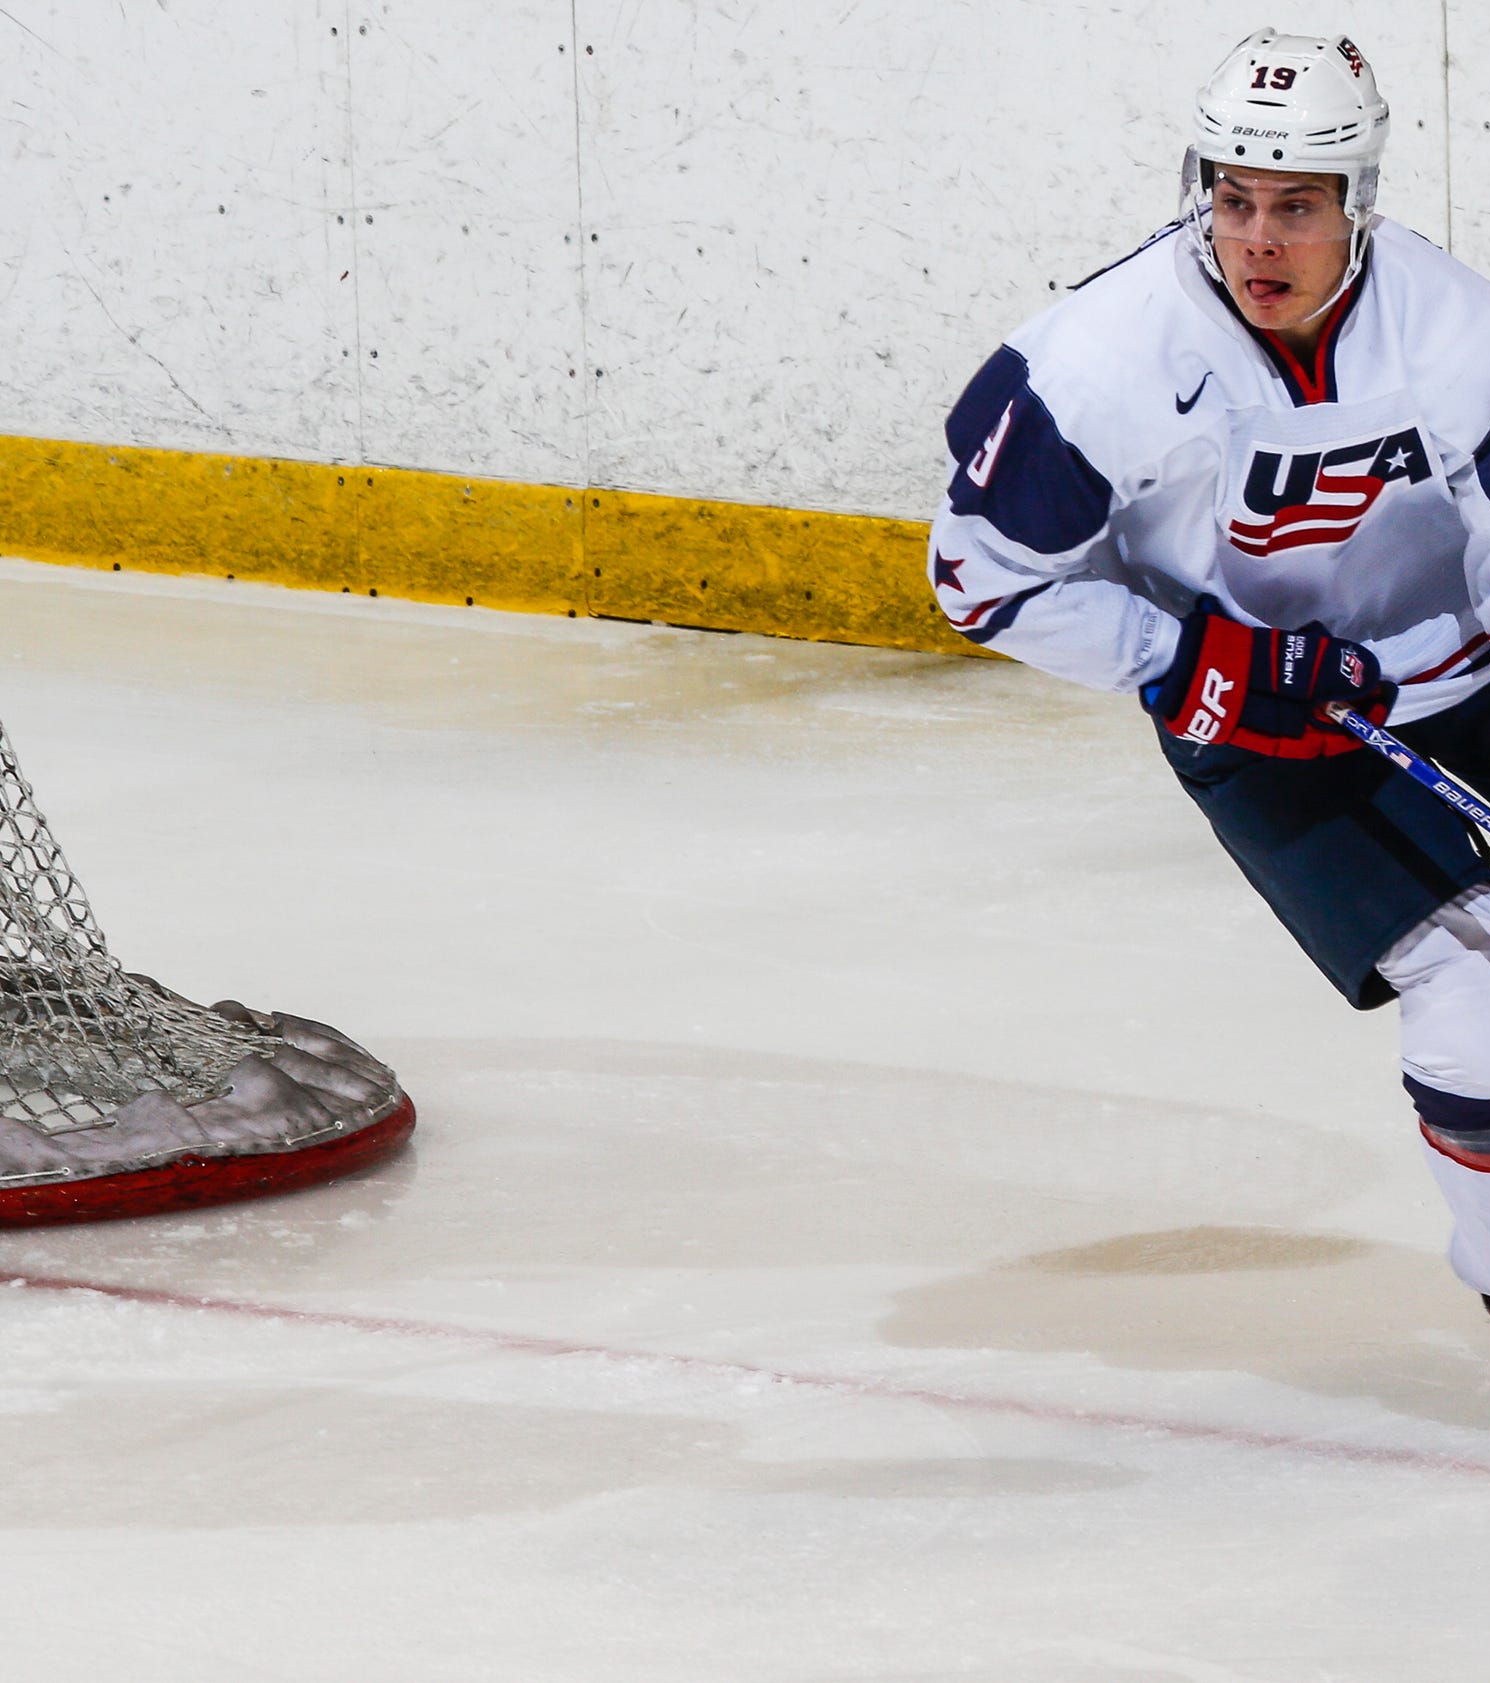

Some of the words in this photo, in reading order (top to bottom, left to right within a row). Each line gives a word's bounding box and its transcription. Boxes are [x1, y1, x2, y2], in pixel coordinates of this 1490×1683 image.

[1250, 66, 1297, 91] 19
[1231, 125, 1289, 140] BAUER
[1231, 427, 1434, 557] USA
[1283, 635, 1295, 684] NEXUS
